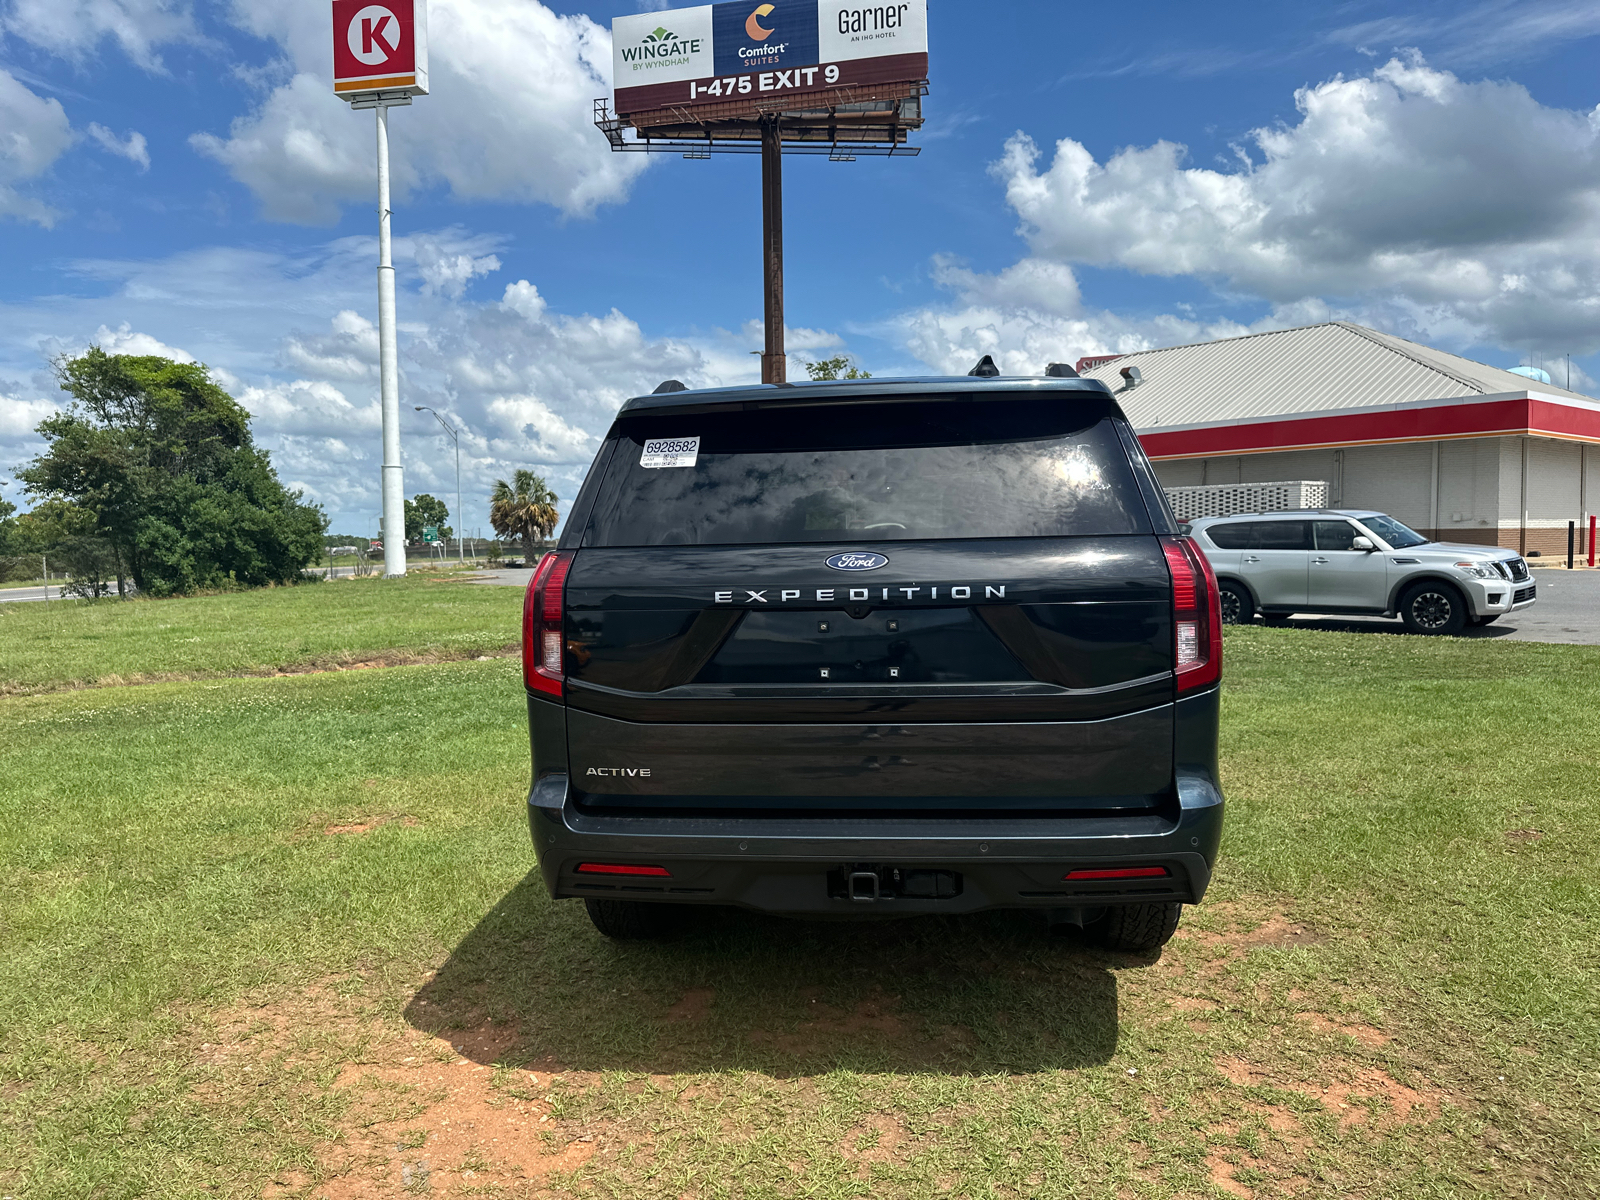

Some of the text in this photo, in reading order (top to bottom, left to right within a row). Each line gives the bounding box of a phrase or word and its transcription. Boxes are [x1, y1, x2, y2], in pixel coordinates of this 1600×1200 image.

[838, 3, 908, 34] Garner
[361, 15, 397, 60] K
[621, 39, 700, 62] WINGATE
[738, 43, 785, 58] Comfort
[632, 57, 690, 71] BY WYNDHAM
[744, 55, 780, 67] SUITES
[690, 64, 840, 99] I-475 EXIT 9
[646, 440, 697, 453] 6928582
[836, 553, 875, 568] Ford
[714, 585, 1006, 603] EXPEDITION
[585, 767, 651, 777] ACTIVE
